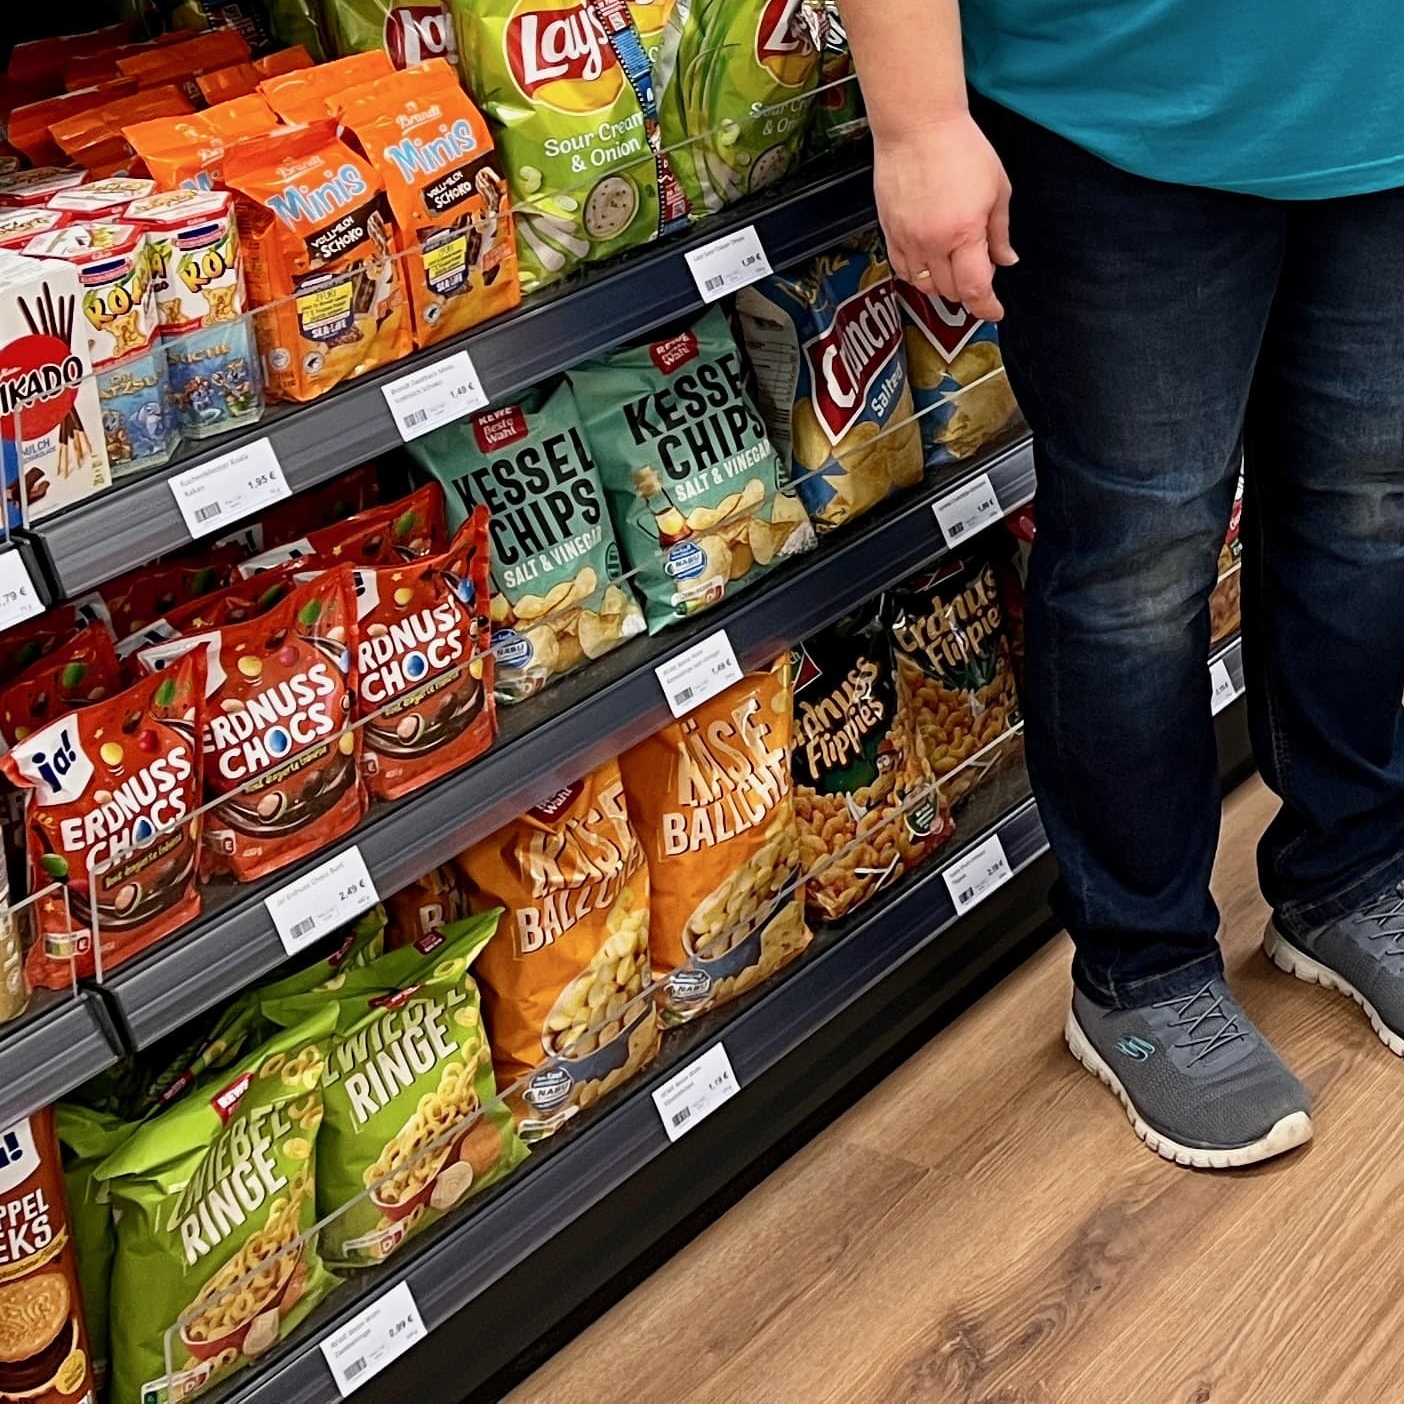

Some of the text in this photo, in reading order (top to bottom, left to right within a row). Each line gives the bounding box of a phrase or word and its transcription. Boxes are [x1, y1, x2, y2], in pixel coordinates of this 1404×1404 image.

[520, 0, 609, 87] Lay's
[398, 107, 442, 130] Brandt
[544, 112, 645, 158] Sour Cream
[749, 100, 786, 121] Sour
[763, 119, 774, 134] &
[275, 154, 325, 180] Brandt
[386, 119, 478, 184] Minis
[571, 136, 642, 173] & Onion
[265, 163, 368, 233] Minis
[426, 171, 464, 199] VOLLMILCH
[434, 179, 472, 211] SCHOKO
[310, 215, 355, 249] VOLLMILCH
[320, 225, 365, 260] SCHOKO
[0, 355, 84, 411] IKADO
[623, 353, 741, 446] KESSE
[871, 361, 904, 417] Salted
[483, 420, 513, 436] Beste
[485, 425, 517, 445] Wahl
[657, 406, 766, 481] CHIPS
[247, 473, 277, 492] 1,95 €
[674, 474, 709, 503] SALT
[711, 467, 723, 485] &
[488, 478, 601, 567] CHIPS
[503, 562, 539, 589] SALT
[539, 555, 550, 573] &
[675, 555, 702, 570] NABU
[357, 594, 463, 674] RDNUSS
[360, 628, 464, 704] CHOCS
[203, 662, 337, 754] ERDNUSS
[790, 656, 882, 750] rdnuss
[32, 729, 78, 794] ja!
[218, 703, 335, 780] CHOCS
[805, 697, 885, 781] Flippies
[61, 746, 191, 852] ERDNUSS
[542, 788, 572, 817] Wahl
[85, 787, 187, 875] CHOCS
[338, 879, 366, 901] 2,49 €
[344, 1004, 459, 1124] RINGE
[180, 1145, 289, 1266] RINGE
